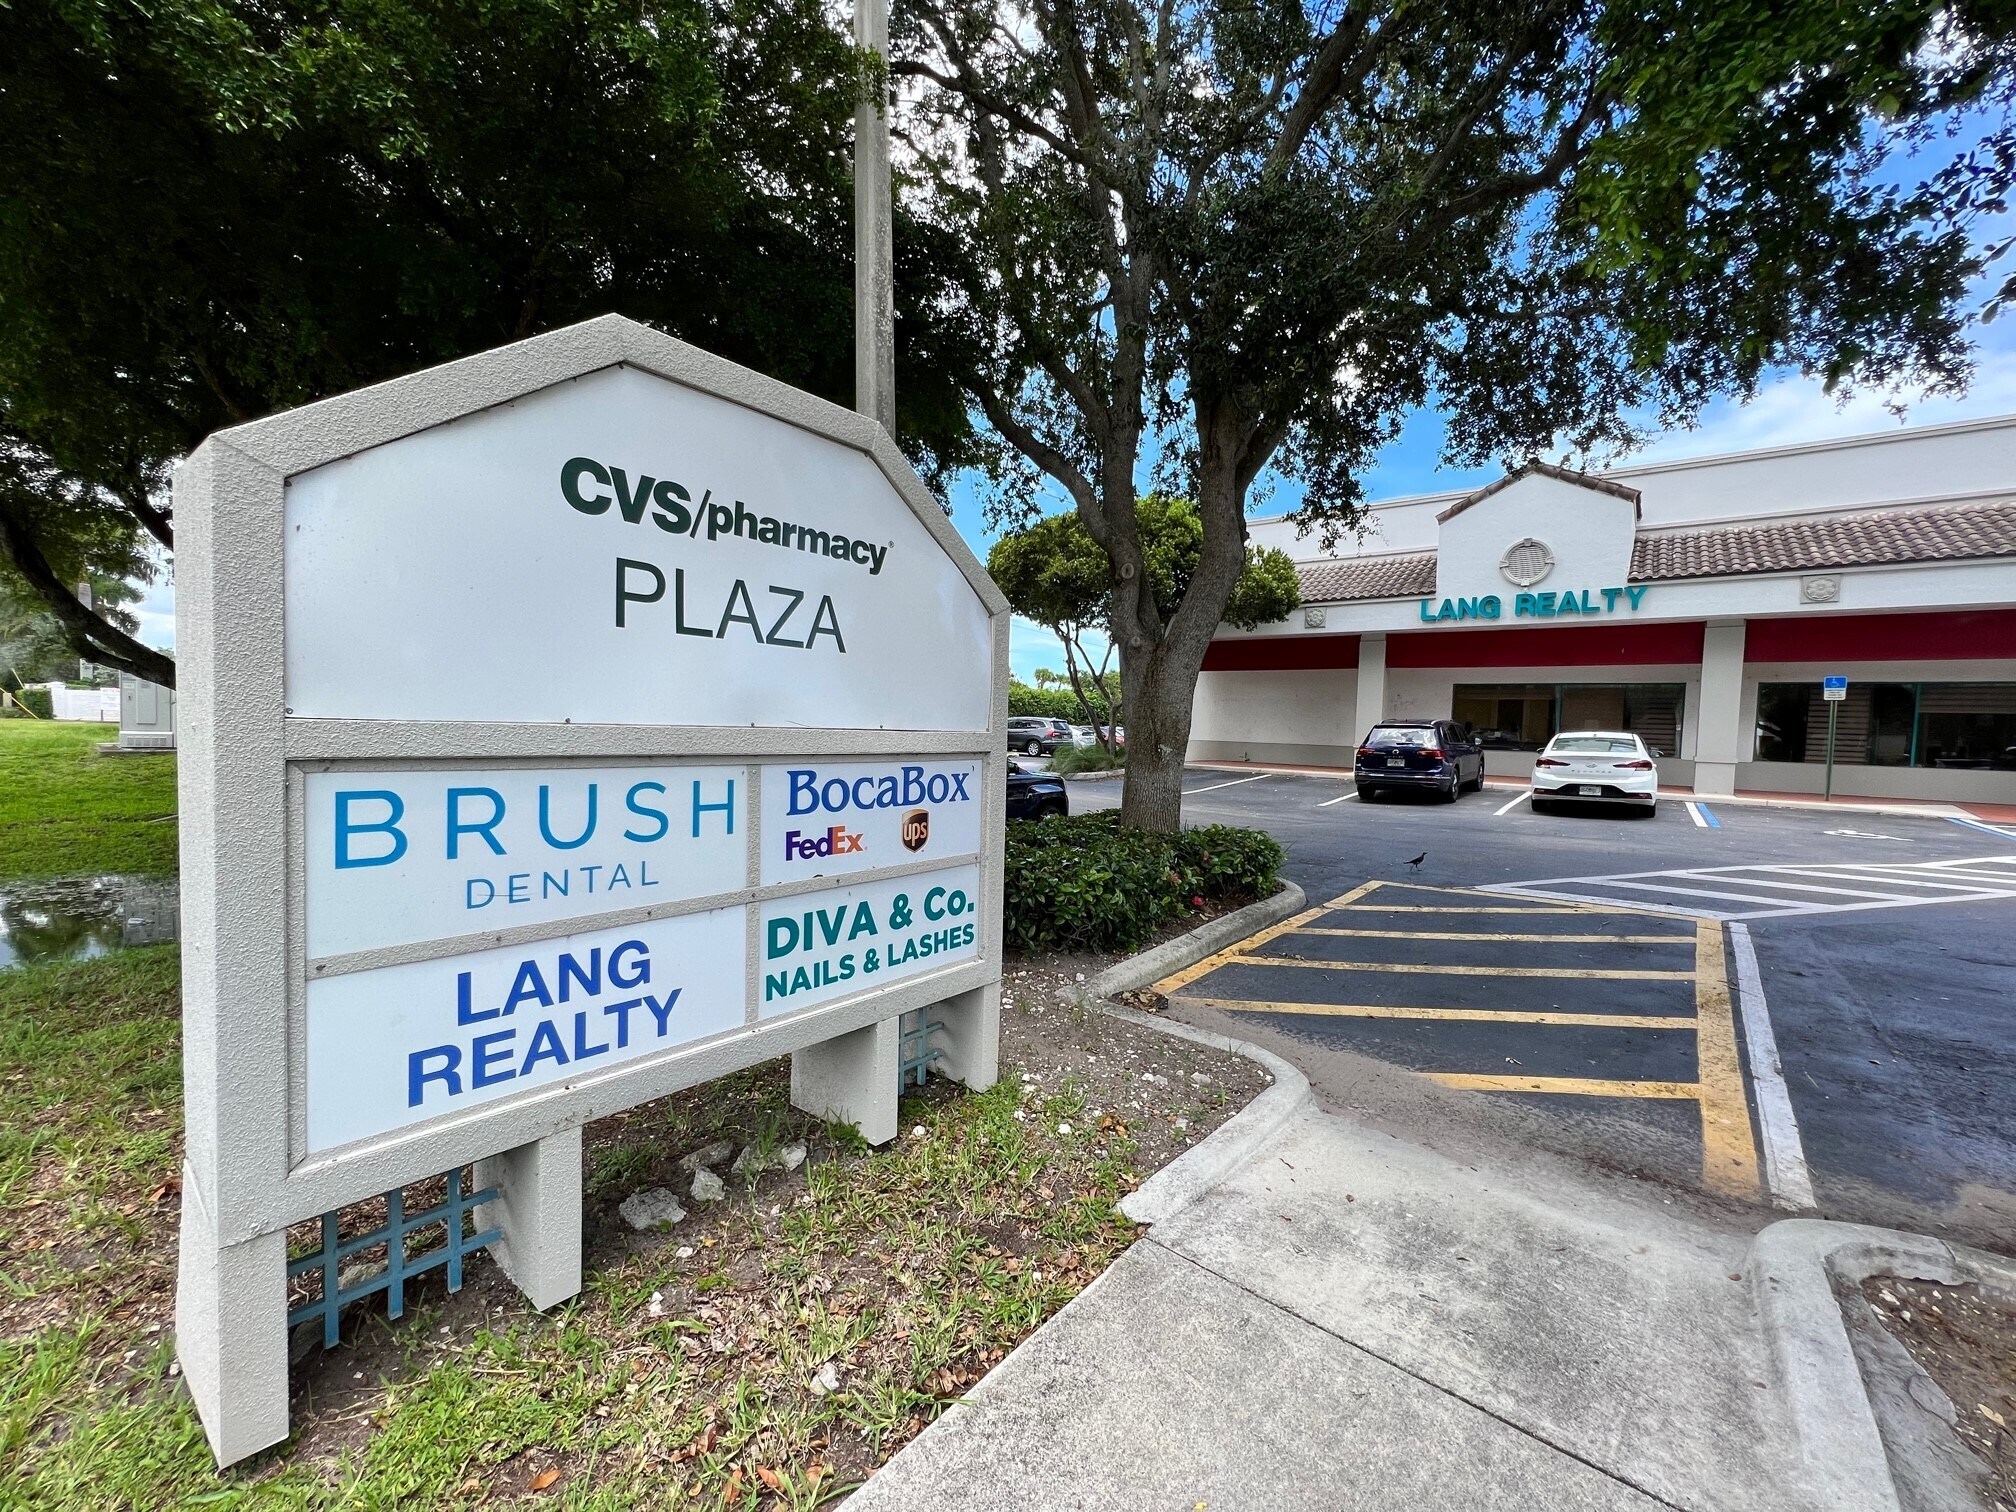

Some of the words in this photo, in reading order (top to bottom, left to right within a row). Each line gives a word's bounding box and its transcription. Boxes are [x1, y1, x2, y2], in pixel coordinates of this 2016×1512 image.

[615, 557, 847, 653] PLAZA
[1420, 595, 1501, 622] LANG
[1514, 586, 1649, 618] REALTY
[335, 779, 735, 869] BRUSH
[785, 825, 864, 861] FedEx
[903, 821, 928, 847] ups
[466, 860, 659, 909] DENTAL
[767, 900, 878, 960] DIVA
[889, 893, 913, 931] &
[923, 886, 975, 922] Co.
[457, 940, 651, 1026] LANG
[765, 954, 856, 1002] NAILS
[863, 948, 880, 974] &
[887, 923, 975, 967] LASHES
[408, 987, 682, 1108] REALTY
